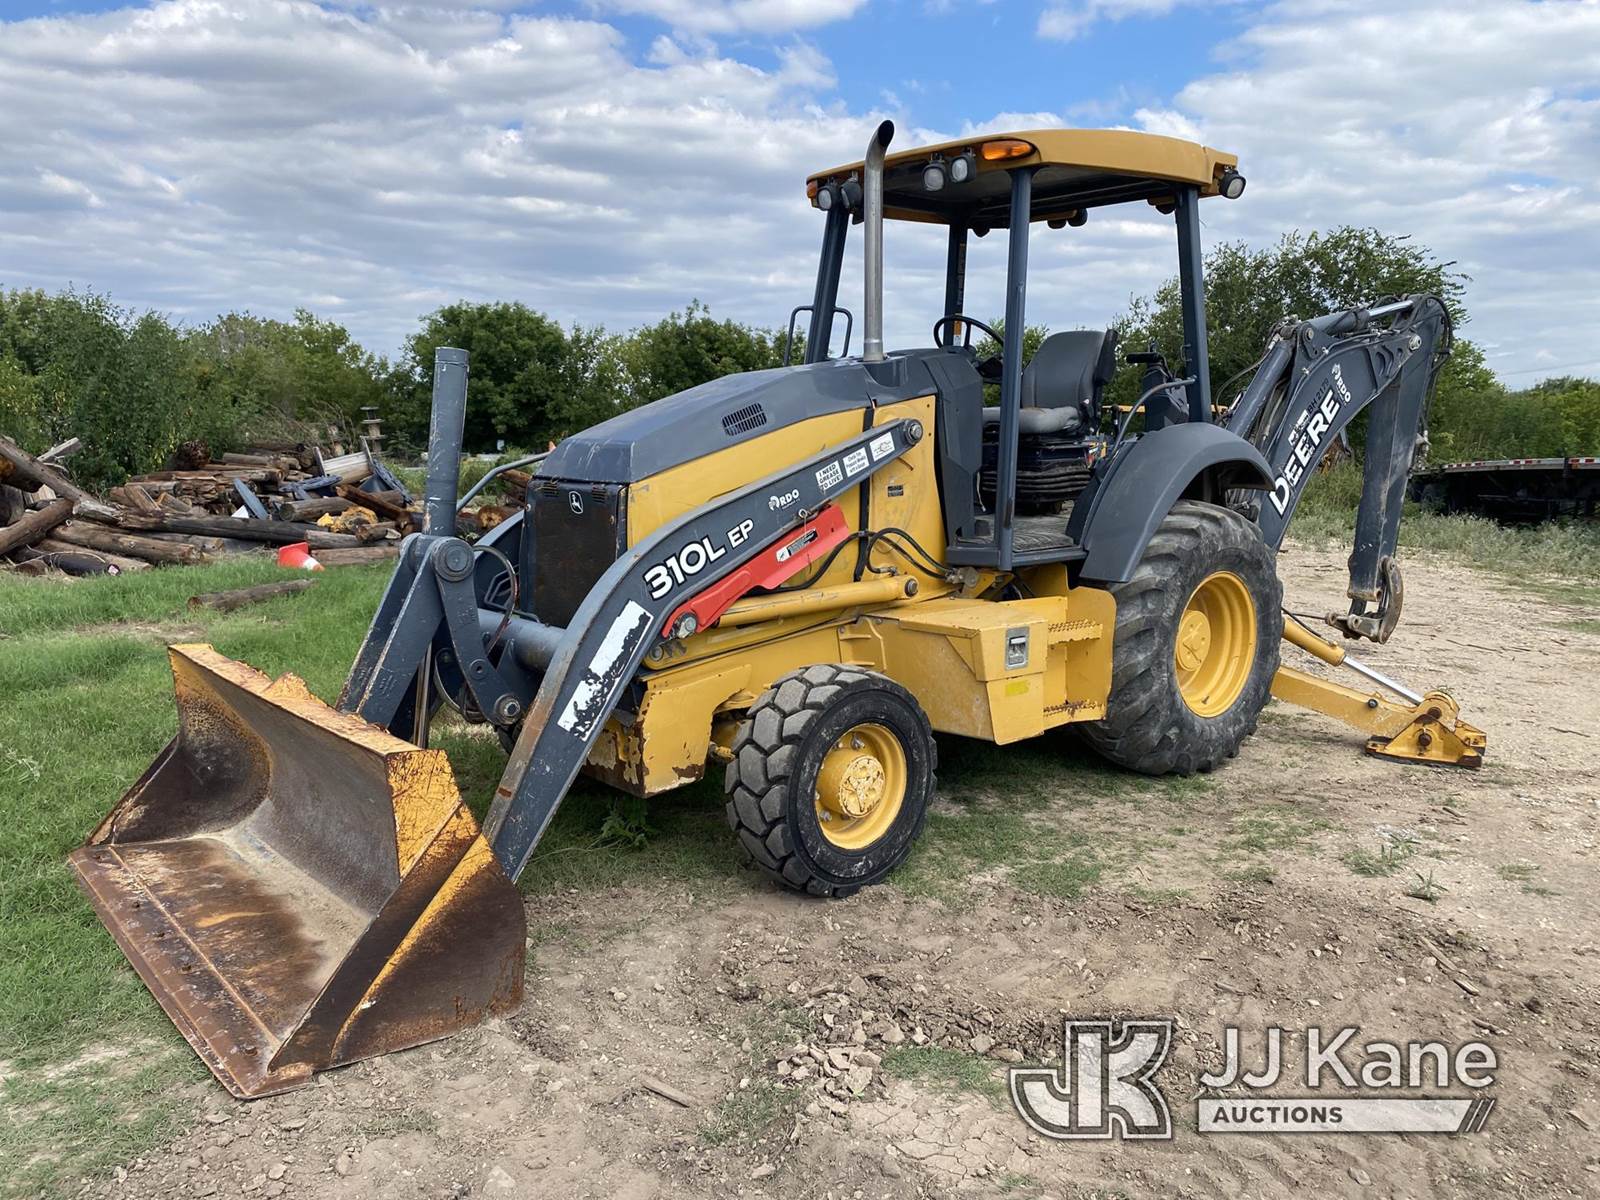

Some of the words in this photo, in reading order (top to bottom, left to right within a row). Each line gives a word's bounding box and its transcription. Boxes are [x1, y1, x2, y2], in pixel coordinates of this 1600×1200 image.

[822, 464, 836, 475] NEED
[1269, 390, 1340, 515] DEERE
[819, 470, 840, 483] GREASE
[644, 536, 726, 599] 310L
[727, 519, 754, 548] EP
